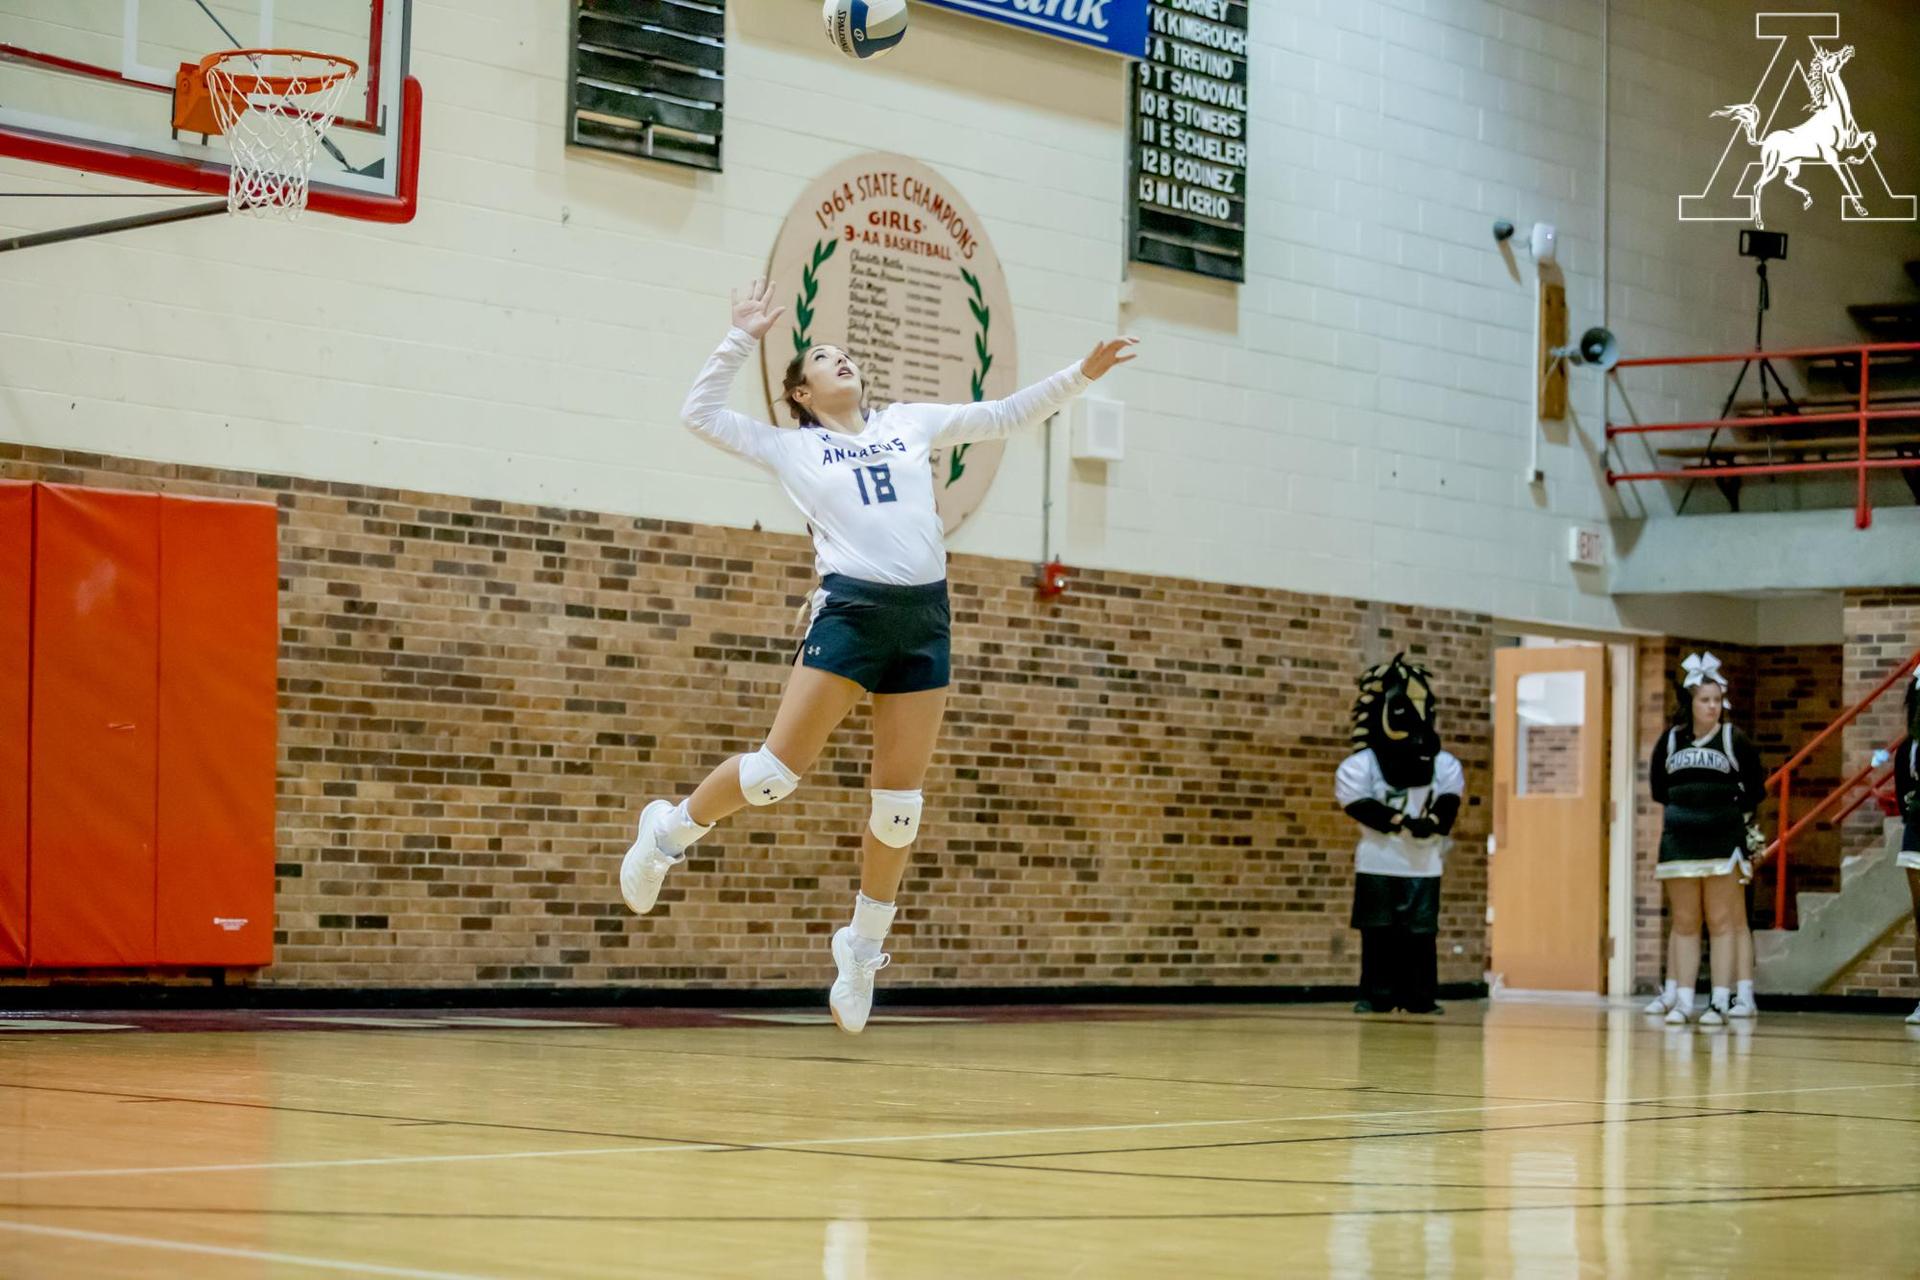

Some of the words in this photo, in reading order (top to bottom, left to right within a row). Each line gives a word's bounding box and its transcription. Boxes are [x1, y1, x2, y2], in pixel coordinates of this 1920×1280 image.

[1154, 8, 1166, 33] K
[1167, 11, 1248, 55] KIMBROUGH
[1153, 38, 1166, 62] A
[1171, 42, 1234, 79] TREVINO
[1140, 62, 1151, 85] 9
[1154, 66, 1165, 89] T
[1170, 71, 1247, 111] SANDOVAL
[1140, 90, 1156, 115] 10
[1157, 95, 1169, 120] R
[1172, 100, 1241, 137] STOWERS
[1143, 119, 1154, 142] 11
[1160, 123, 1171, 147] E
[1174, 128, 1246, 167] SCHUELER
[1143, 148, 1158, 173] 12
[1160, 153, 1172, 176] B
[816, 183, 854, 229] 1964
[857, 173, 899, 201] STATE
[903, 177, 978, 260] CHAMPIONS
[1140, 177, 1155, 202] 13
[1171, 185, 1230, 219] LICERIO
[868, 211, 922, 234] GIRLS
[884, 233, 952, 261] BASKETBALL
[852, 463, 898, 505] 18
